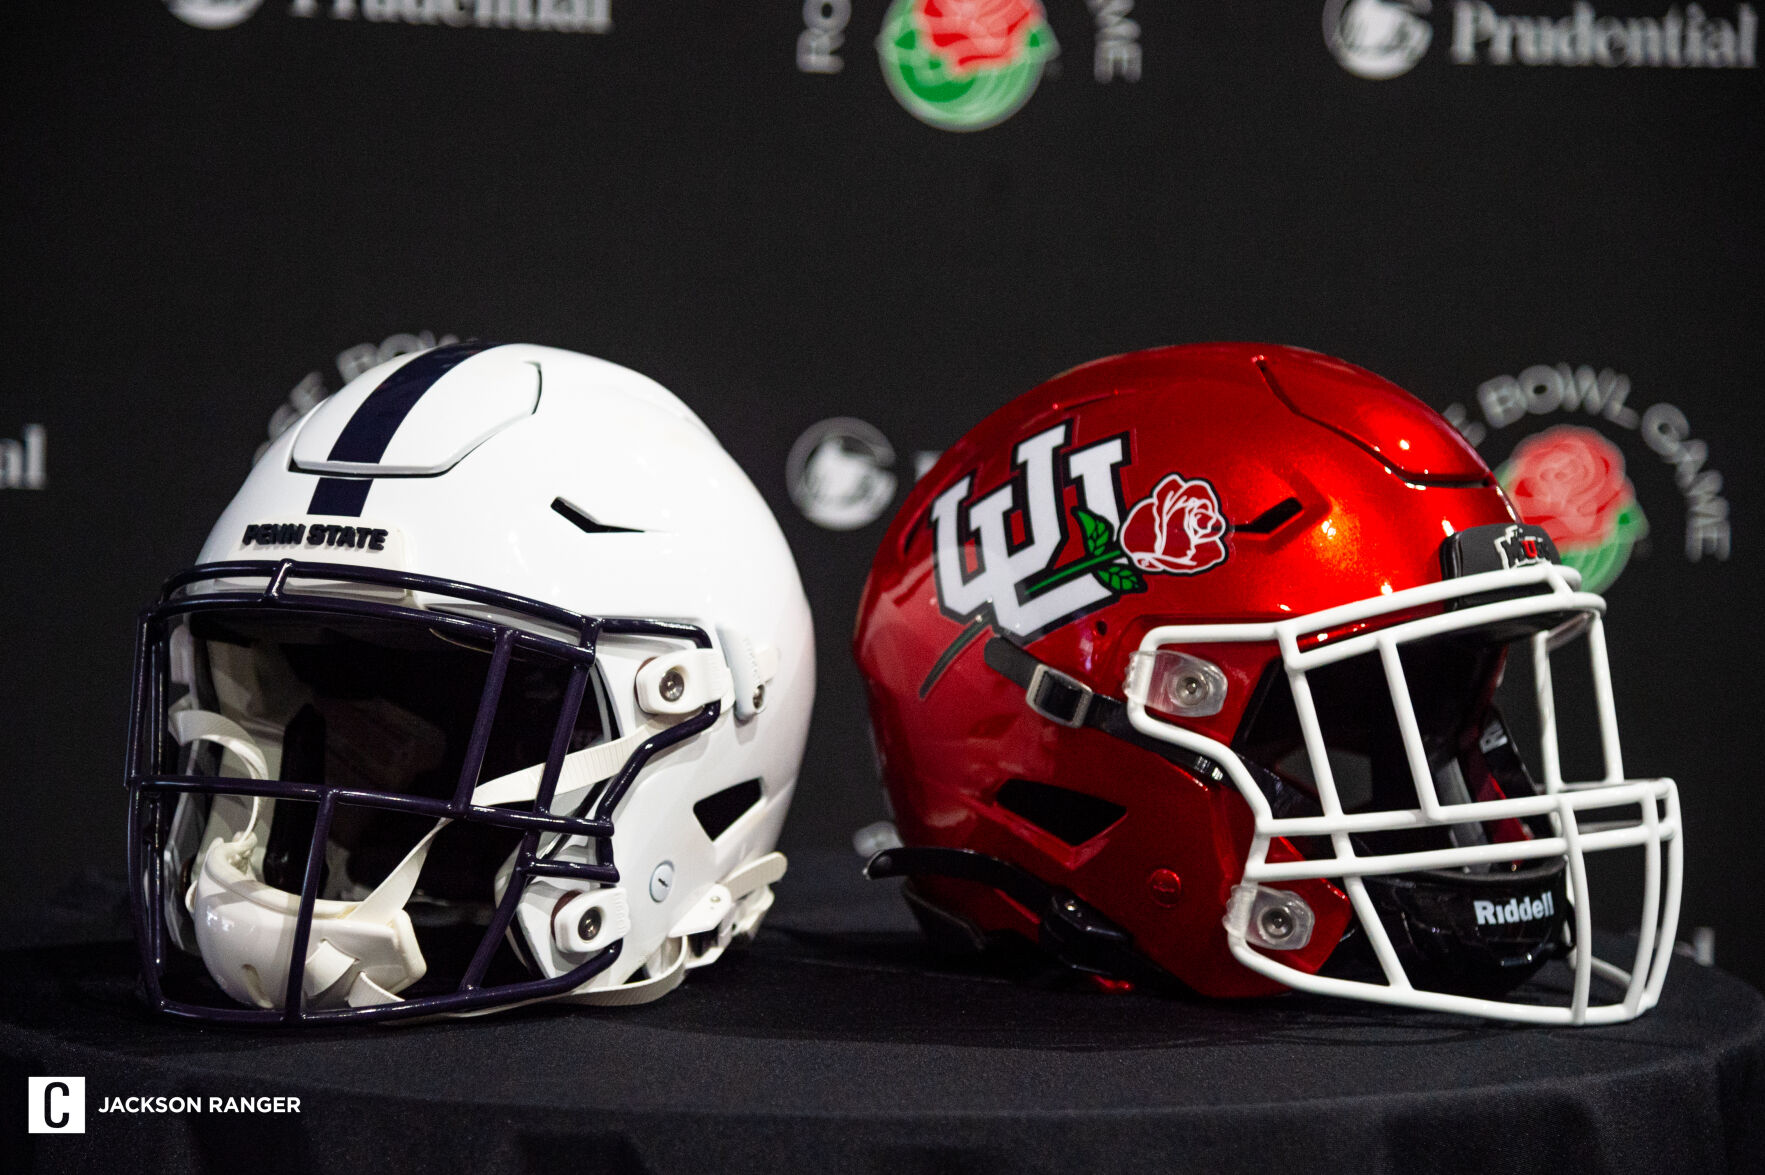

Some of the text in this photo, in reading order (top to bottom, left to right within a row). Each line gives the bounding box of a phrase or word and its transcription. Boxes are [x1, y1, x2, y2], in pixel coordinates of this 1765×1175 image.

[1450, 0, 1758, 67] Prudential
[1477, 361, 1640, 430] BOWL
[1641, 402, 1731, 562] GAME
[242, 522, 389, 551] PENN STATE
[1473, 890, 1555, 925] Riddell
